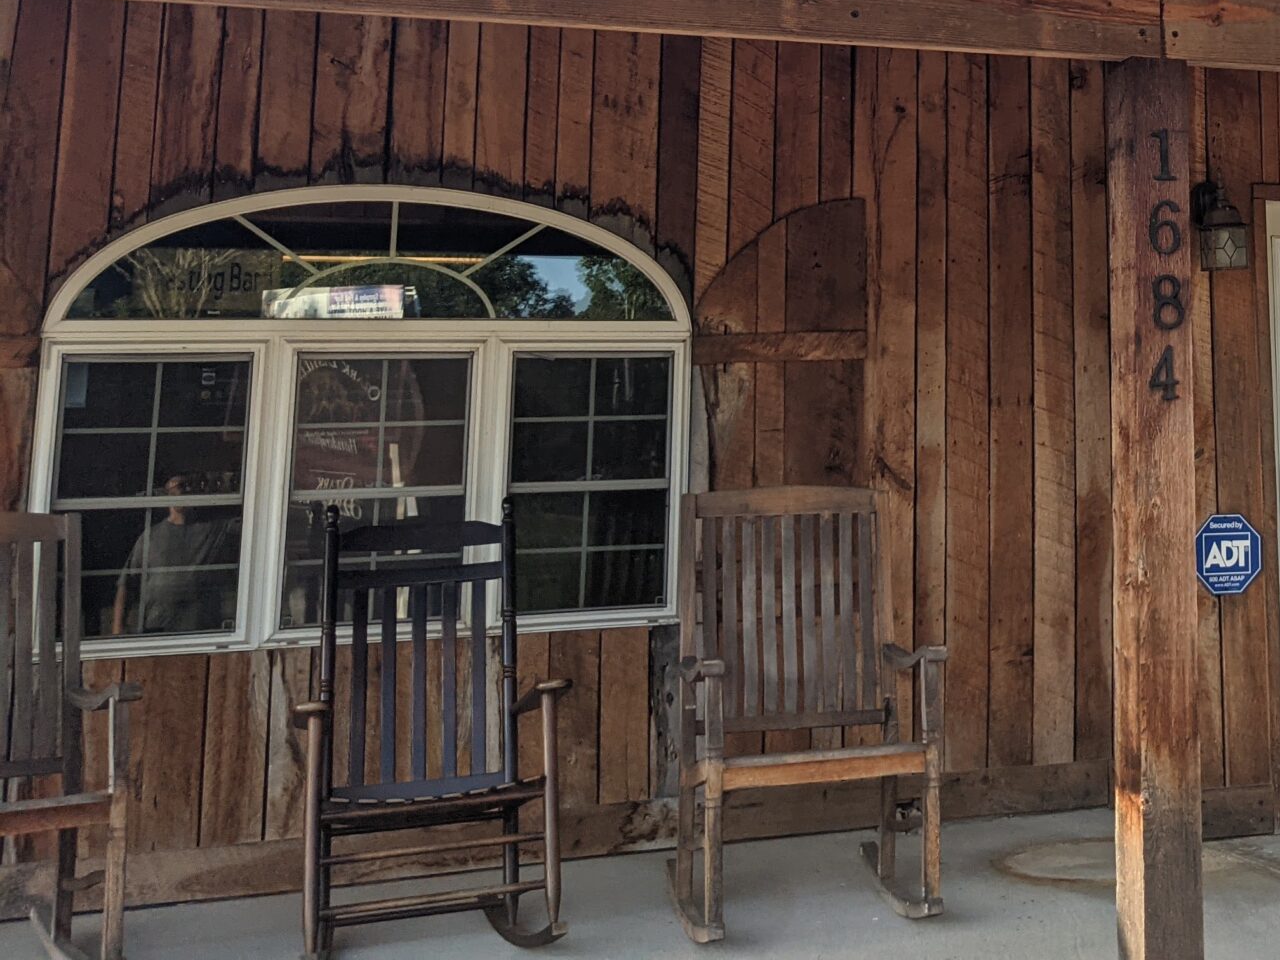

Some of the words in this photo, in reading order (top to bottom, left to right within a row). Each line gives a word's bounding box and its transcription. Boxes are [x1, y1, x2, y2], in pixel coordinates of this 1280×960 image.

[229, 262, 262, 291] Bar
[1149, 128, 1185, 402] 1684
[1209, 521, 1234, 529] Secured
[1234, 521, 1243, 530] by
[1205, 539, 1250, 568] ADT
